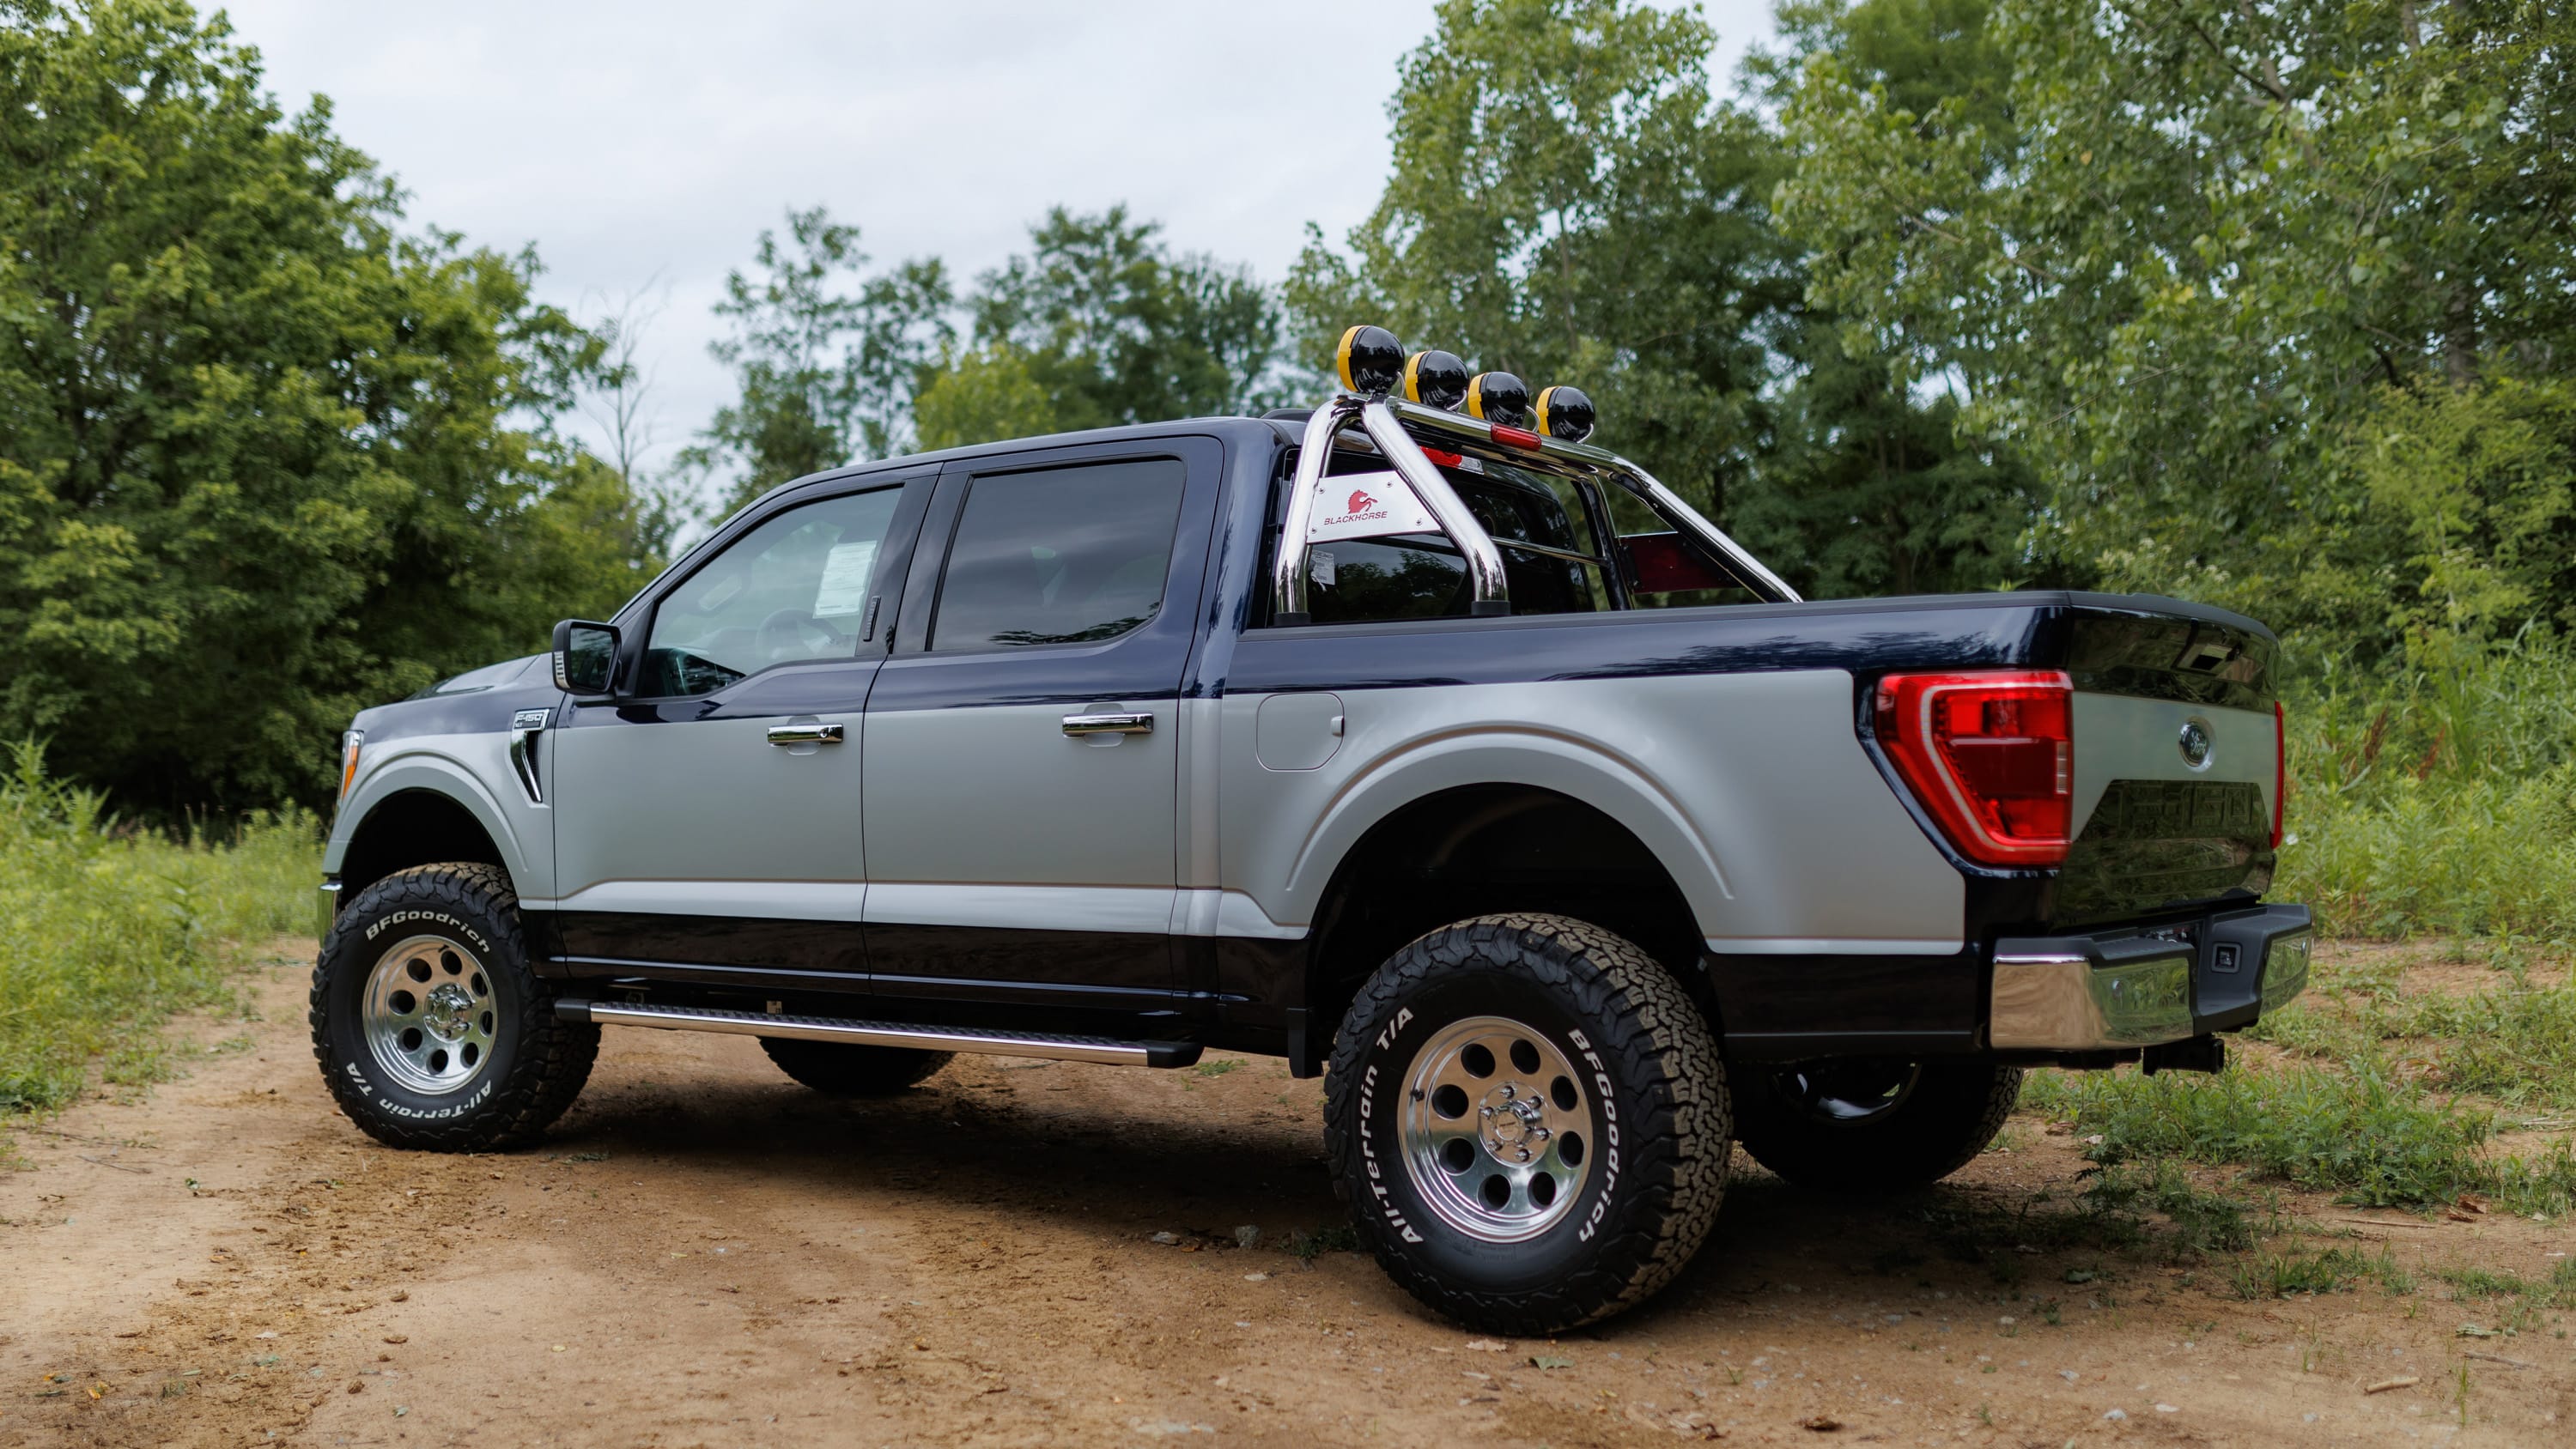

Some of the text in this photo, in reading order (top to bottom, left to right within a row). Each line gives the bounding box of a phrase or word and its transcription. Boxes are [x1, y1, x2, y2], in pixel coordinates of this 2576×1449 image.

[1323, 511, 1388, 525] BLACKHORSE
[365, 910, 490, 954] BFGoodrich
[346, 1062, 492, 1119] All-Terrain T/A
[1360, 1007, 1424, 1244] All-Terrain T/A
[1567, 1028, 1621, 1243] BFGoodrich
